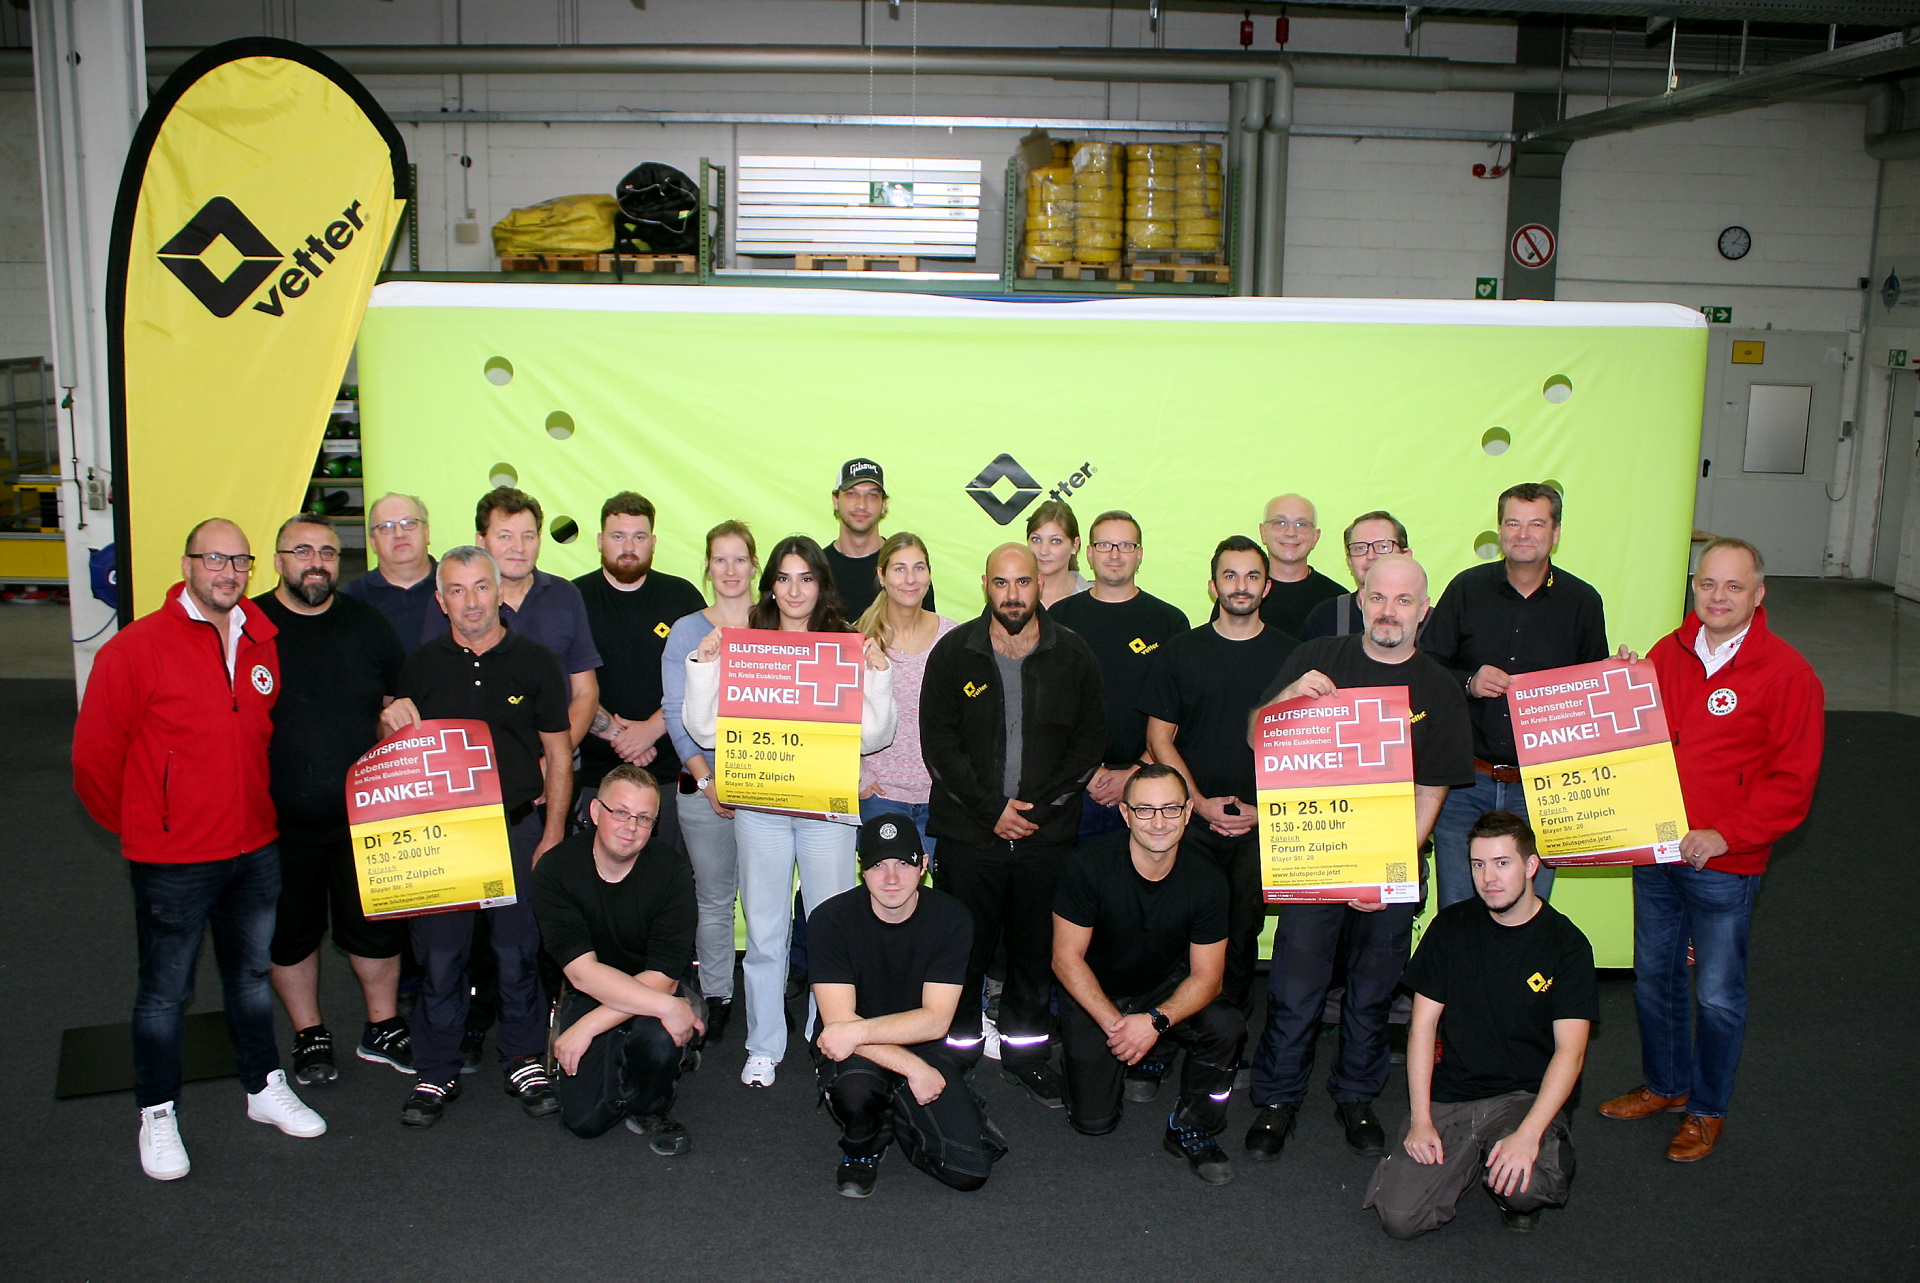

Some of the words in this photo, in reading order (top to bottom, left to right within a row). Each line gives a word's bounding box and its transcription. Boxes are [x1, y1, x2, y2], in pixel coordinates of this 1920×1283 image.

[252, 199, 364, 317] vetter
[850, 461, 879, 477] Gibson
[729, 643, 810, 655] BLUTSPENDER
[729, 659, 792, 670] Lebensretter
[727, 686, 799, 704] DANKE!
[1516, 679, 1599, 700] BLUTSPENDER
[1264, 706, 1349, 723] BLUTSPENDER
[1519, 699, 1583, 715] Lebensretter
[1549, 710, 1586, 721] Euskirchen
[727, 731, 742, 743] Di
[753, 732, 775, 745] 25.
[781, 733, 804, 746] 10.
[1264, 726, 1331, 738] Lebensretter
[1523, 722, 1600, 749] DANKE!
[1293, 738, 1331, 746] Euskirchen
[357, 736, 436, 765] BLUTSPENDER
[726, 749, 747, 759] 15.30
[755, 751, 777, 760] 20.00
[780, 752, 795, 761] Uhr
[355, 756, 418, 777] Lebensretter
[1264, 752, 1343, 772] DANKE!
[383, 768, 420, 778] Euskirchen
[725, 770, 756, 779] Forum
[759, 772, 795, 782] Zülpich
[1534, 776, 1551, 791] Di
[1561, 771, 1586, 786] 25.
[1592, 767, 1616, 781] 10.
[355, 781, 434, 807] DANKE!
[1537, 794, 1560, 806] 15.30
[1568, 789, 1591, 801] 20.00
[1594, 787, 1610, 797] Uhr
[1270, 803, 1287, 816] Di
[1298, 801, 1322, 815] 25.
[1330, 800, 1353, 813] 10.
[1539, 807, 1568, 816] Zülpich
[1541, 815, 1573, 826] Forum
[1577, 807, 1615, 820] Zülpich
[1270, 822, 1294, 832] 15.30
[1302, 820, 1326, 831] 20.00
[1329, 820, 1345, 829] Uhr
[364, 835, 381, 849] Di
[392, 830, 416, 844] 25.
[423, 825, 447, 839] 10.
[1270, 835, 1300, 843] Zülpich
[366, 853, 389, 864] 15.30
[398, 848, 421, 860] 20.00
[424, 846, 440, 856] Uhr
[1272, 845, 1305, 853] Forum
[1309, 842, 1347, 852] Zülpich
[368, 865, 397, 875] Zülpich
[369, 874, 403, 885] Forum
[406, 867, 444, 879] Zülpich
[1272, 870, 1340, 878] www.blutspende.jetzt
